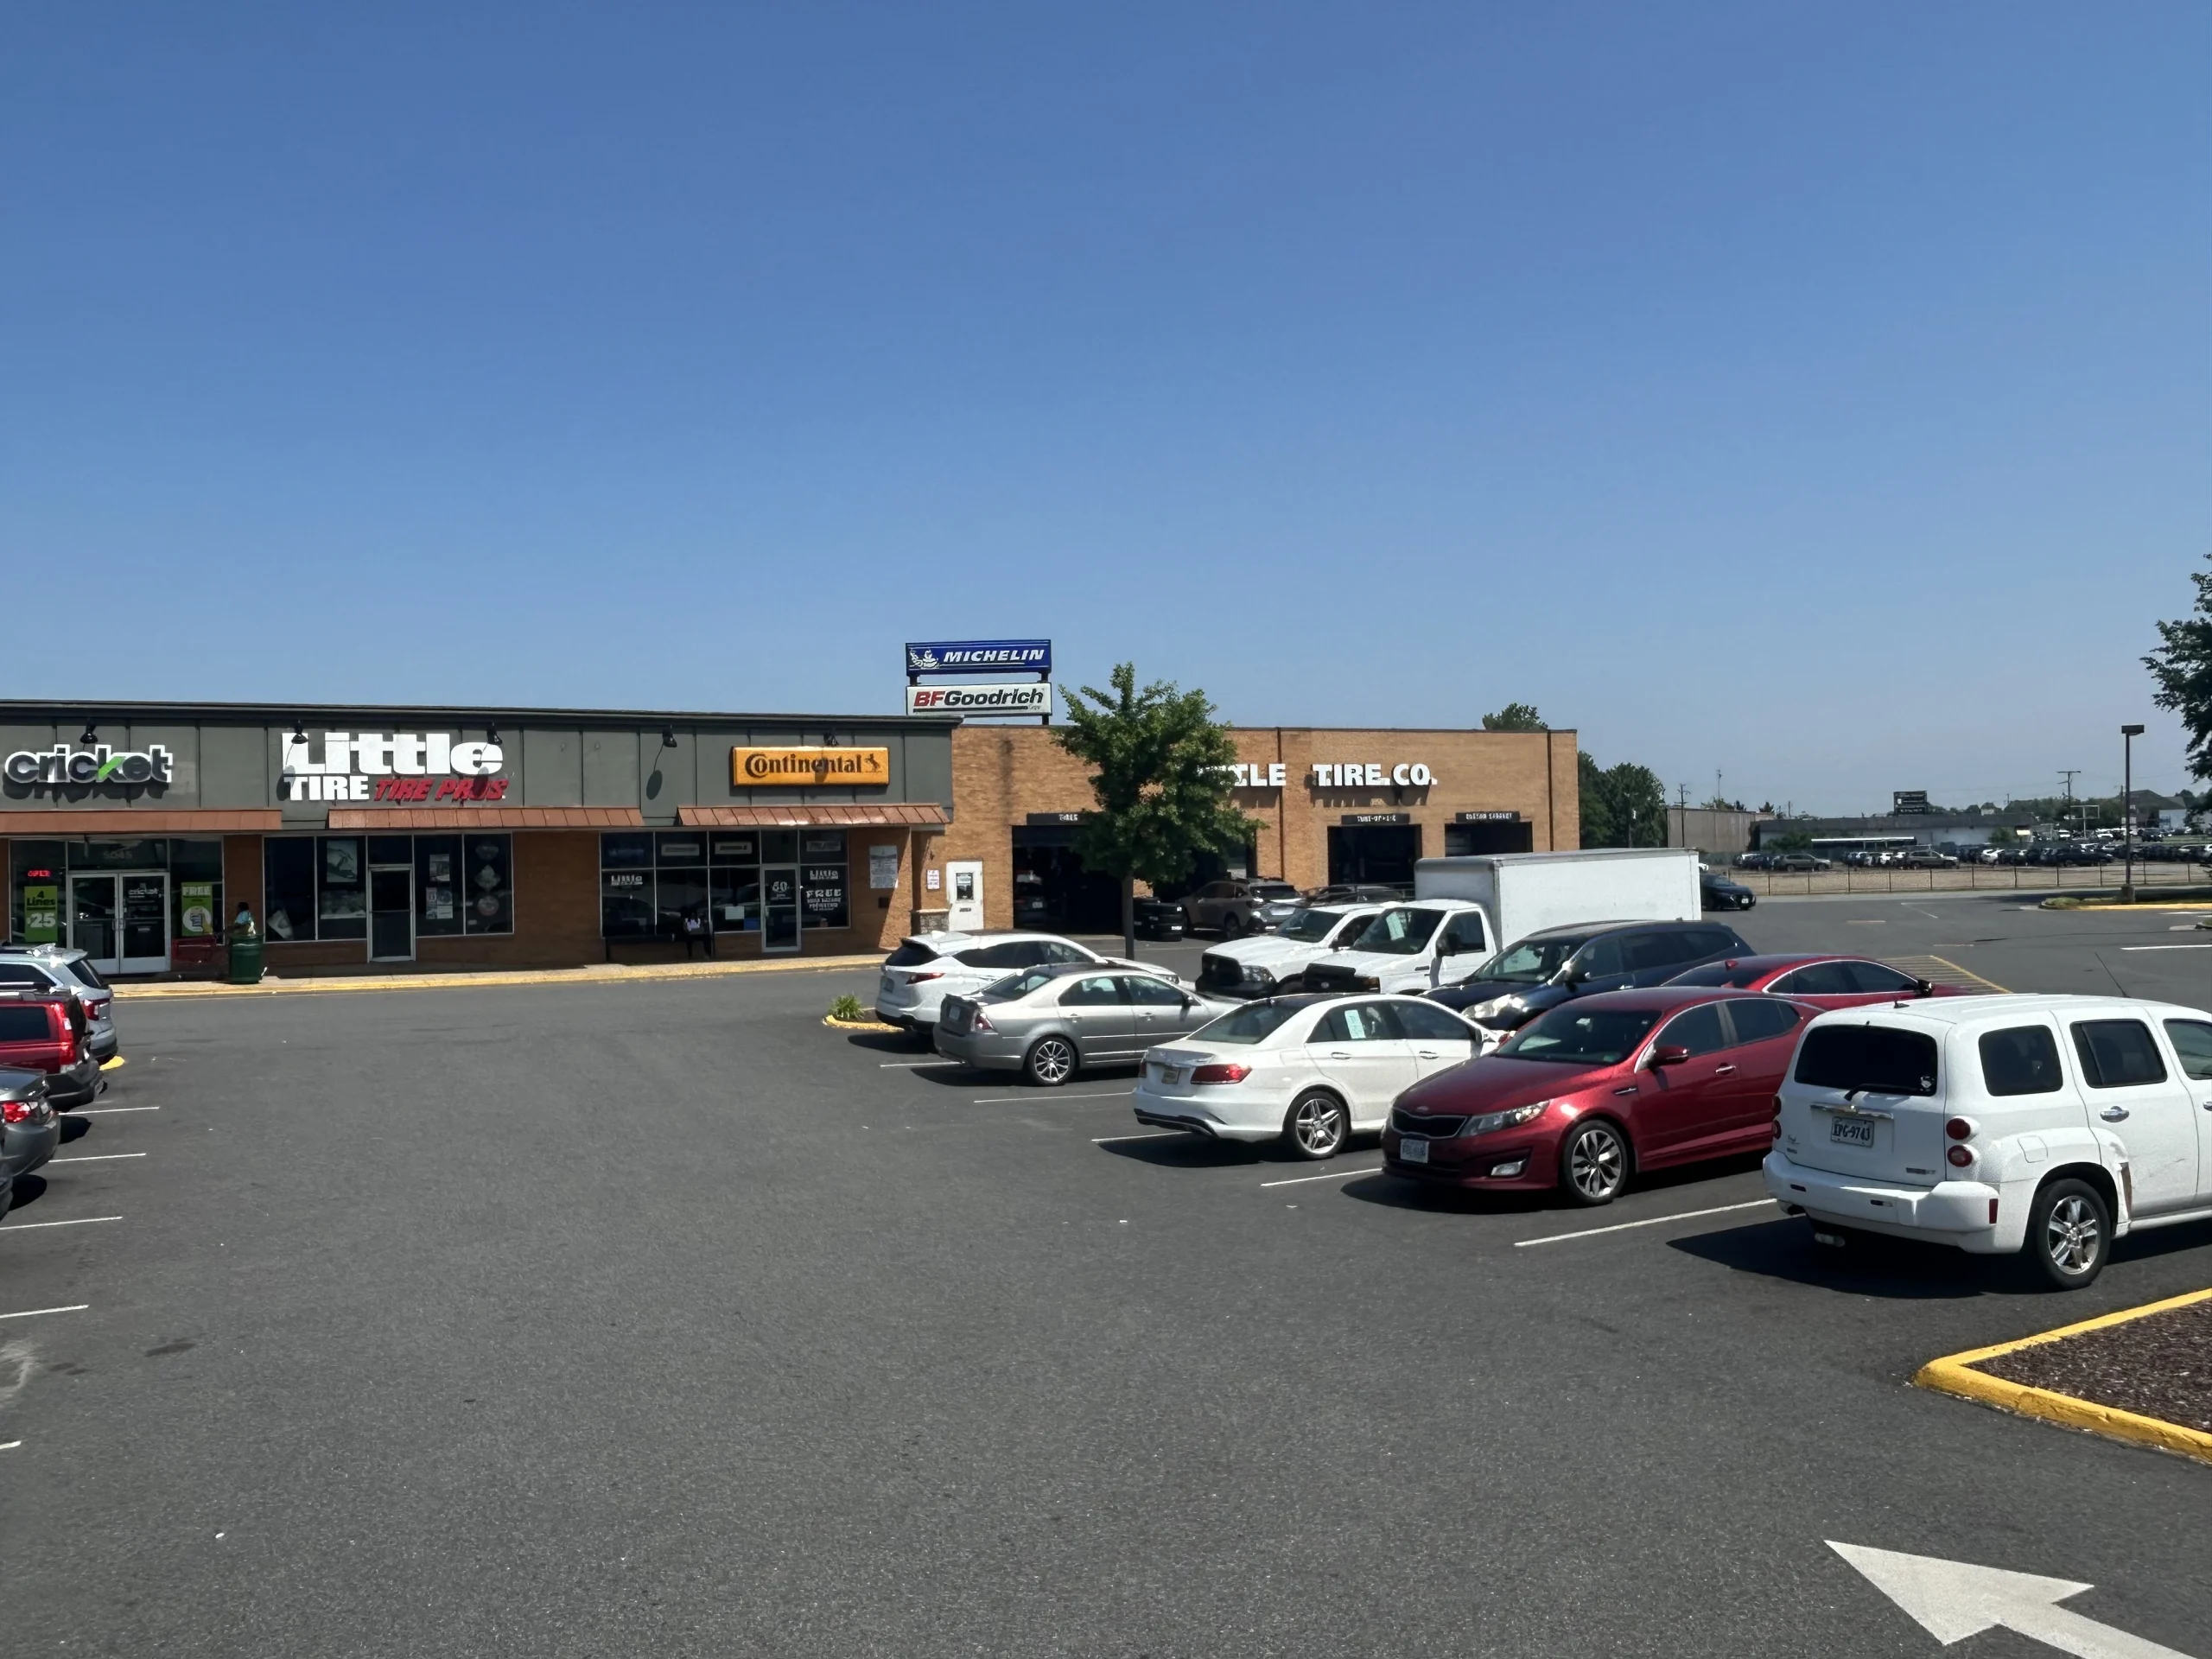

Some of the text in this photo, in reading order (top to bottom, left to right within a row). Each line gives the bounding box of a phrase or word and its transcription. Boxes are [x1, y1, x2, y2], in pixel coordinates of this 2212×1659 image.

[944, 650, 1045, 663] MICHELIN
[913, 688, 1044, 707] BFGoodrich
[4, 744, 173, 783] cricket
[282, 732, 503, 774] Little
[745, 753, 861, 779] Continental
[283, 775, 370, 801] TIRE
[373, 778, 435, 802] TIRE
[26, 897, 56, 906] Lines
[36, 890, 45, 899] 4
